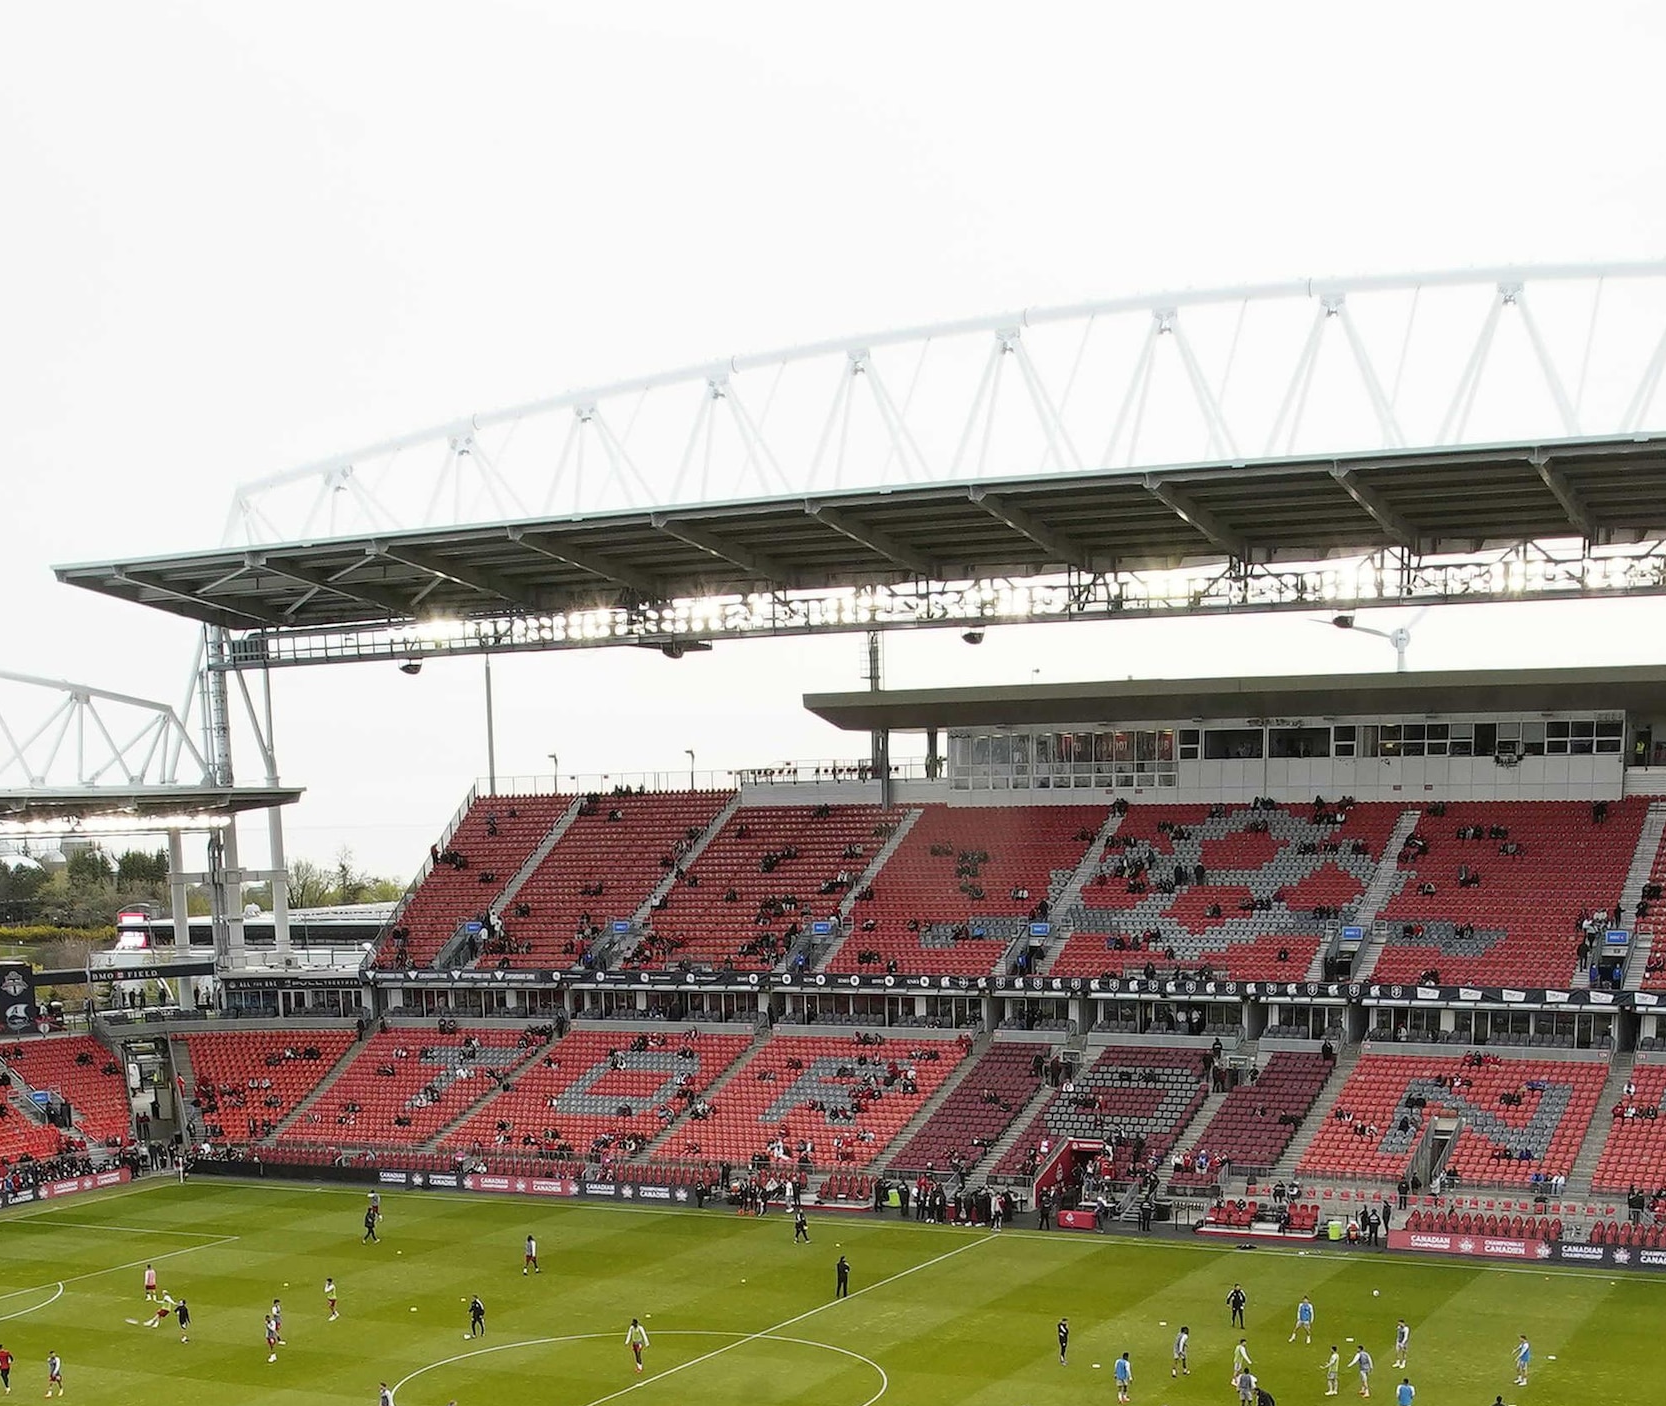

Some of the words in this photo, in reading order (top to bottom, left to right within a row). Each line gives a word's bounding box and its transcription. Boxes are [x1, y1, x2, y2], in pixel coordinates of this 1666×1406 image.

[1411, 1235, 1450, 1244] CANADIAN
[1484, 1245, 1525, 1255] CANADIEN
[1561, 1245, 1603, 1254] CANADIAN
